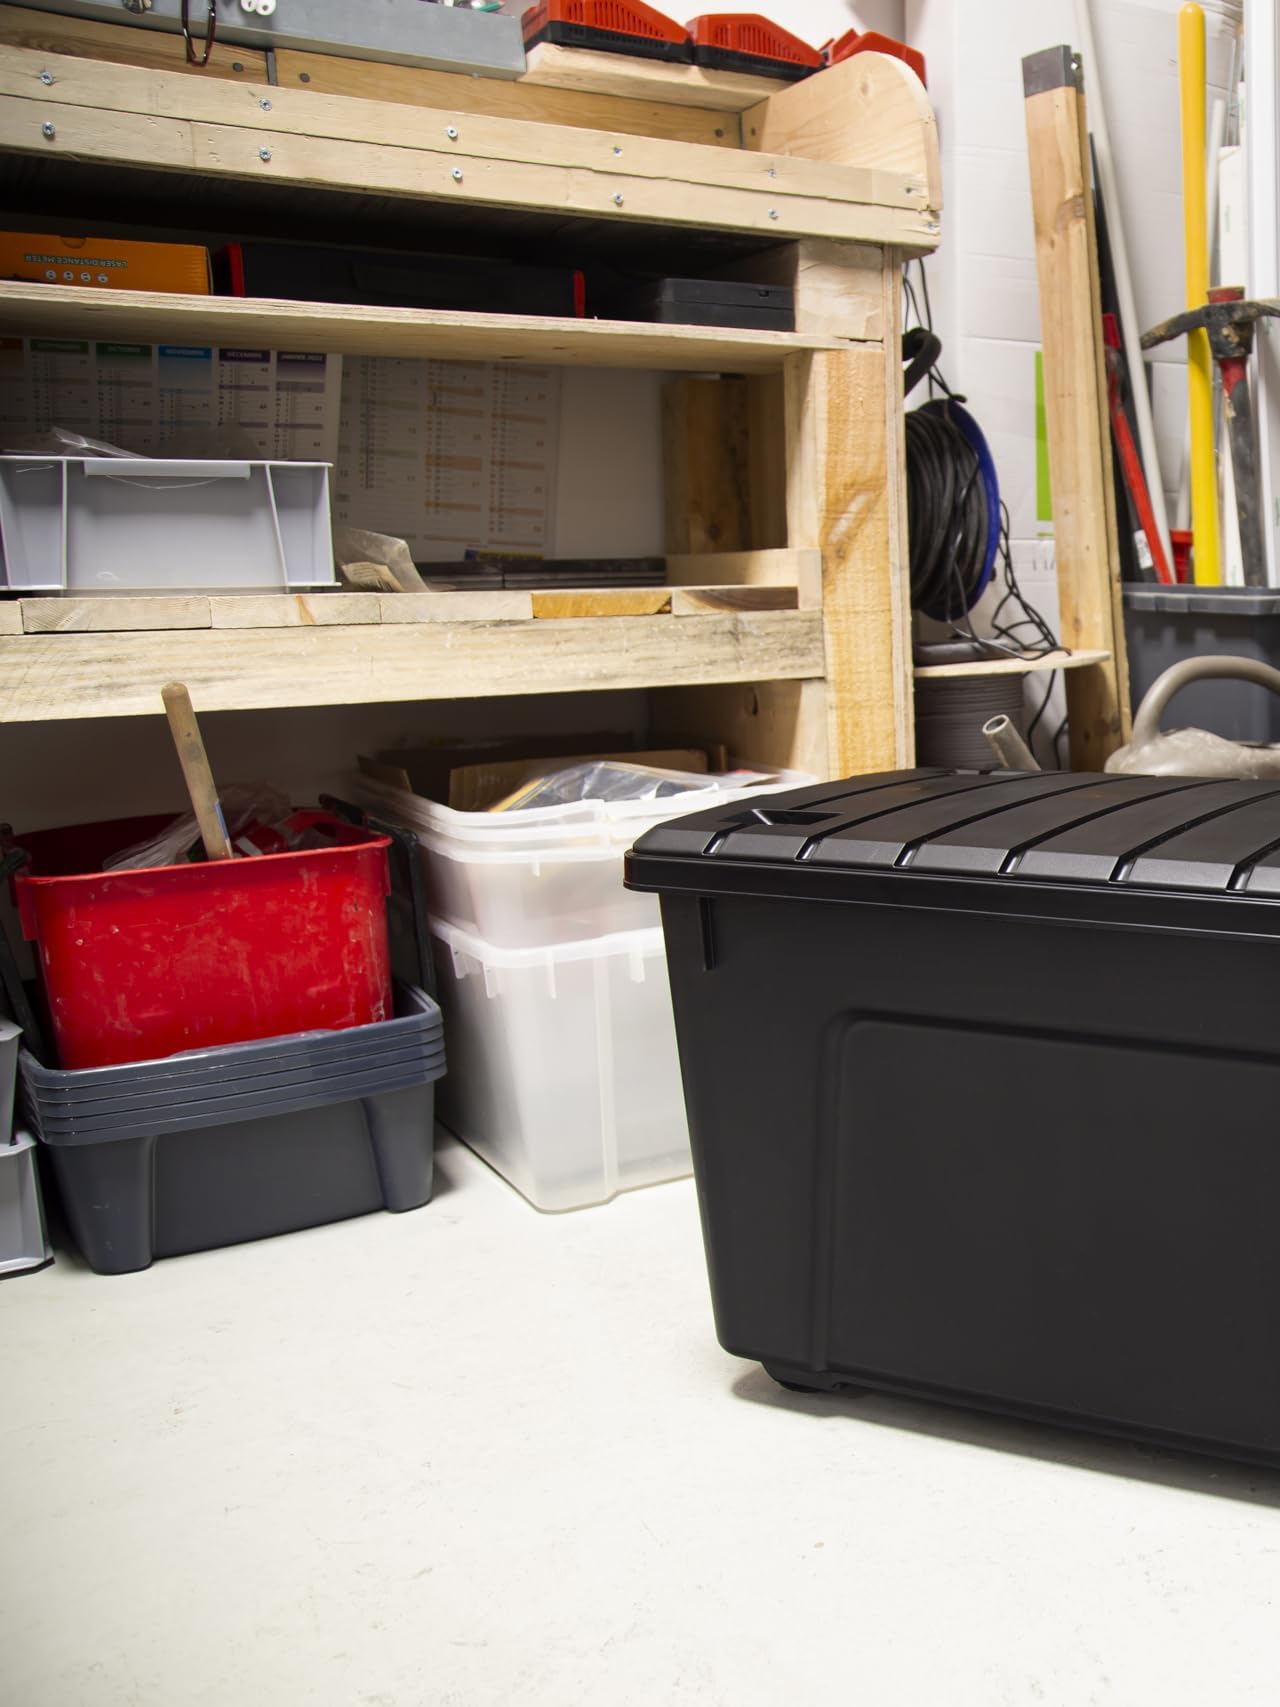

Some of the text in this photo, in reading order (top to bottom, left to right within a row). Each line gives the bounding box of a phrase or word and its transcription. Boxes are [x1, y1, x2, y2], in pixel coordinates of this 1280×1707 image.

[25, 254, 128, 268] LASER DISTANCE METER
